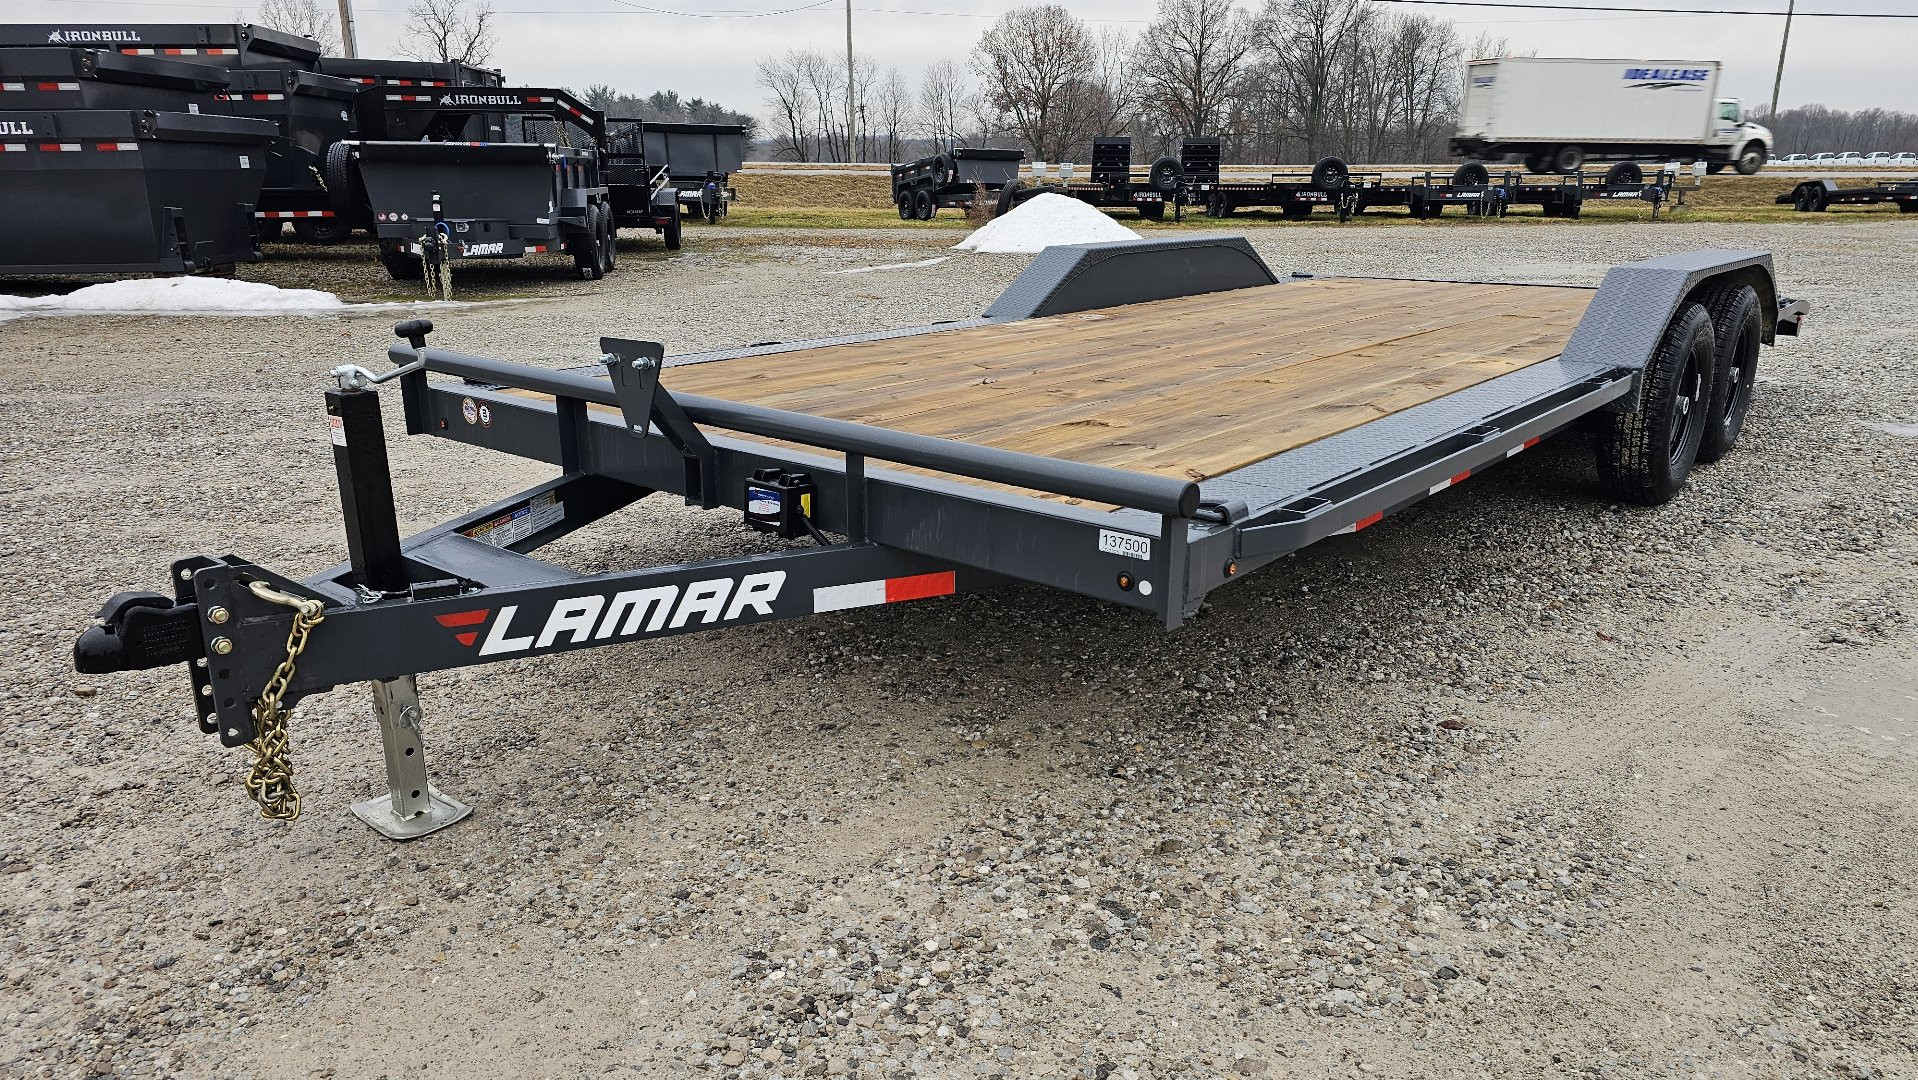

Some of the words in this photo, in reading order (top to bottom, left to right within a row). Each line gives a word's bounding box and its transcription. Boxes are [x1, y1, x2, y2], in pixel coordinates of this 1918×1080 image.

[64, 31, 141, 42] IRONBULL
[1623, 68, 1709, 81] IDEALEASE
[454, 94, 522, 105] IRONBULL
[463, 242, 504, 257] LAMAR
[1103, 534, 1148, 554] 137500
[479, 570, 787, 657] LAMAR
